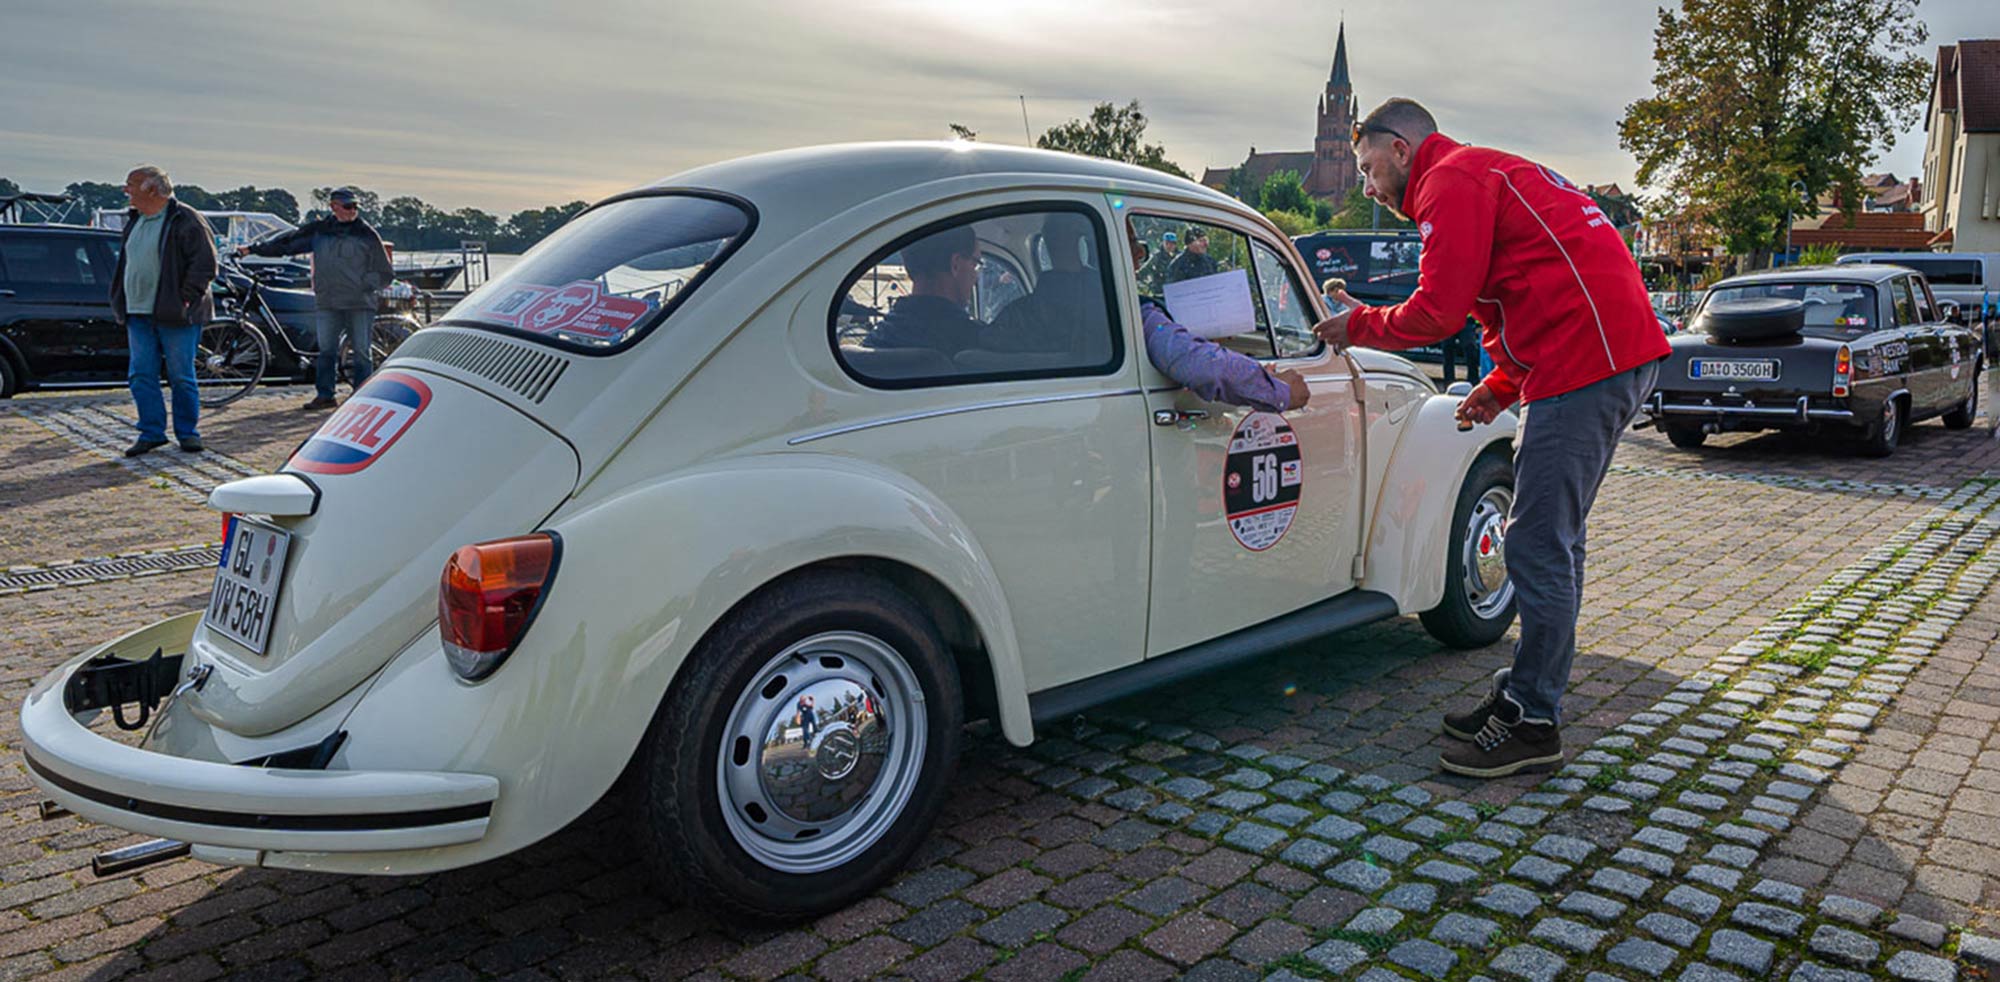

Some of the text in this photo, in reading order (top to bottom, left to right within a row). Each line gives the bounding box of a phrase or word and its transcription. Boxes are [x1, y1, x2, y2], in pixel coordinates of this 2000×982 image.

[1702, 363, 1716, 376] DA
[1732, 363, 1771, 377] 3500H
[1252, 452, 1278, 502] 56
[233, 530, 255, 579] GL
[212, 575, 269, 644] VW 58H
